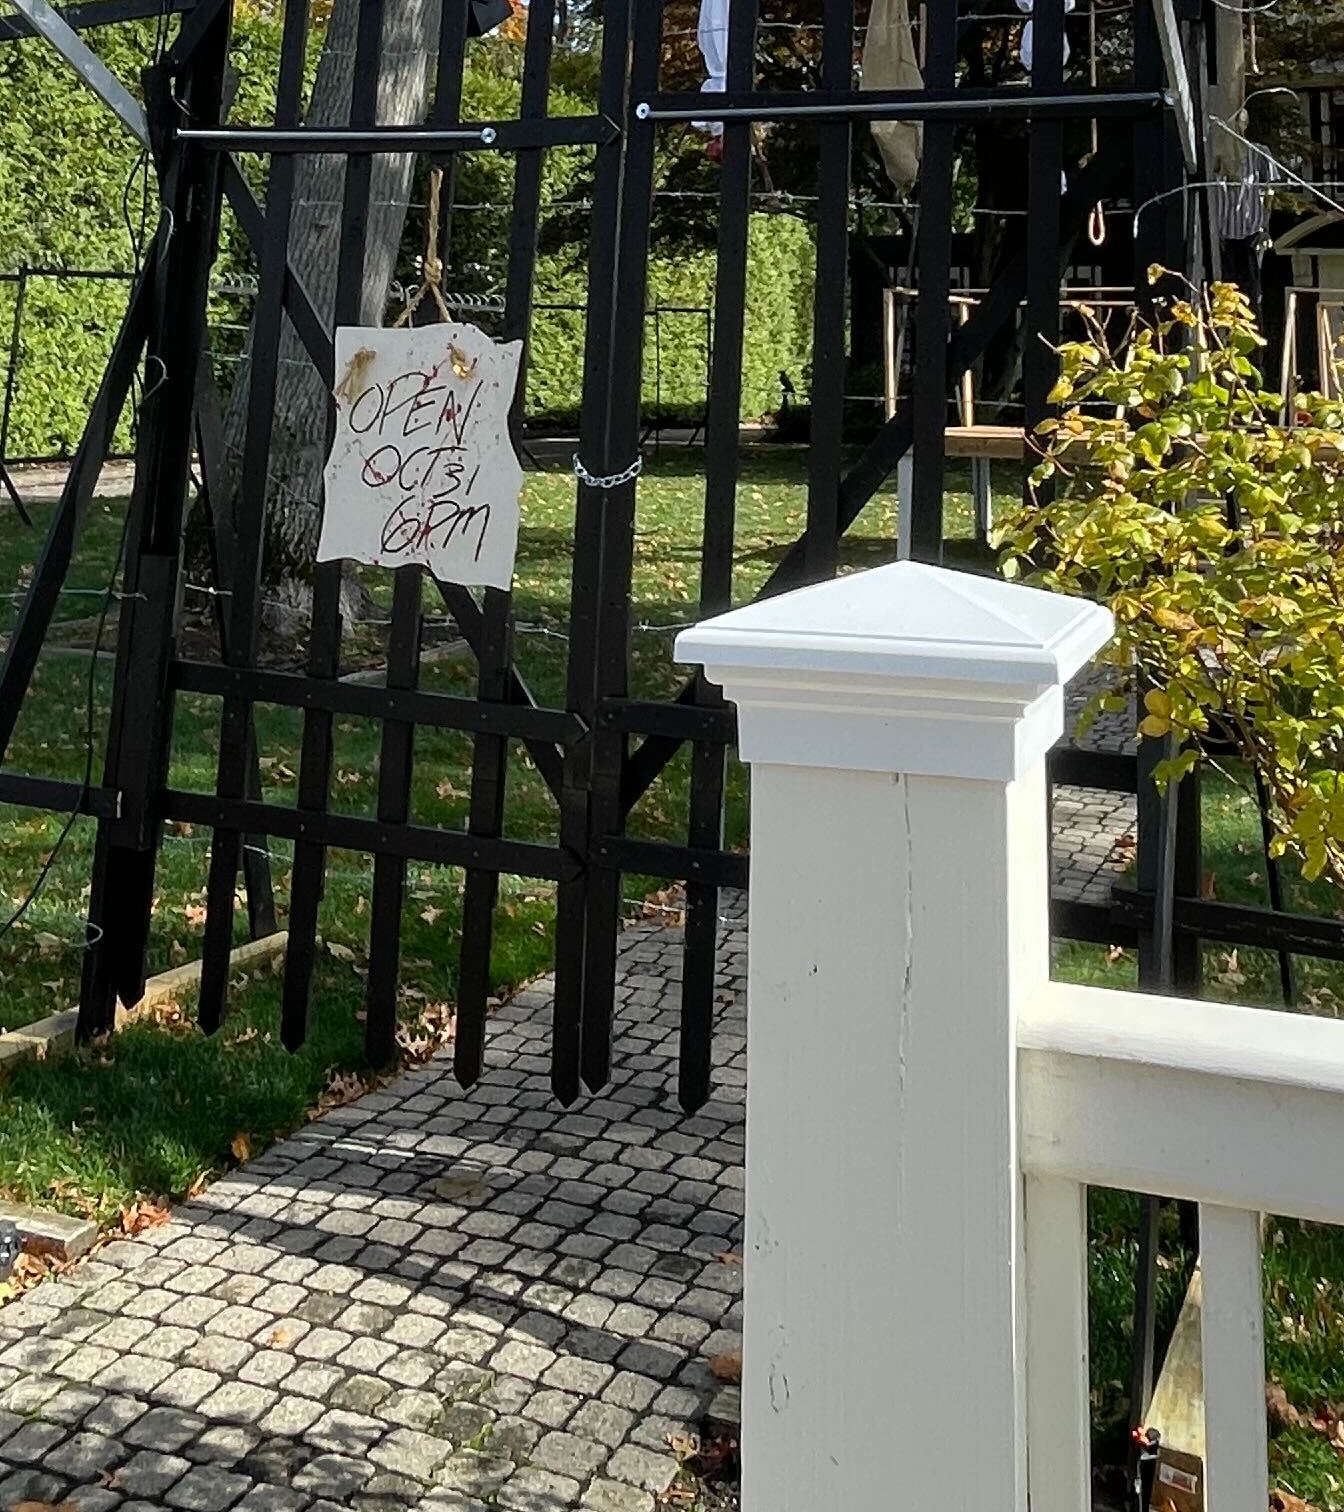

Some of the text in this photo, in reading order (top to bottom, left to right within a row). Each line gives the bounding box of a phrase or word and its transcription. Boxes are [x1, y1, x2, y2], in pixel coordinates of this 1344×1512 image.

[349, 372, 484, 445] OPEN
[361, 444, 480, 499] OCT 31
